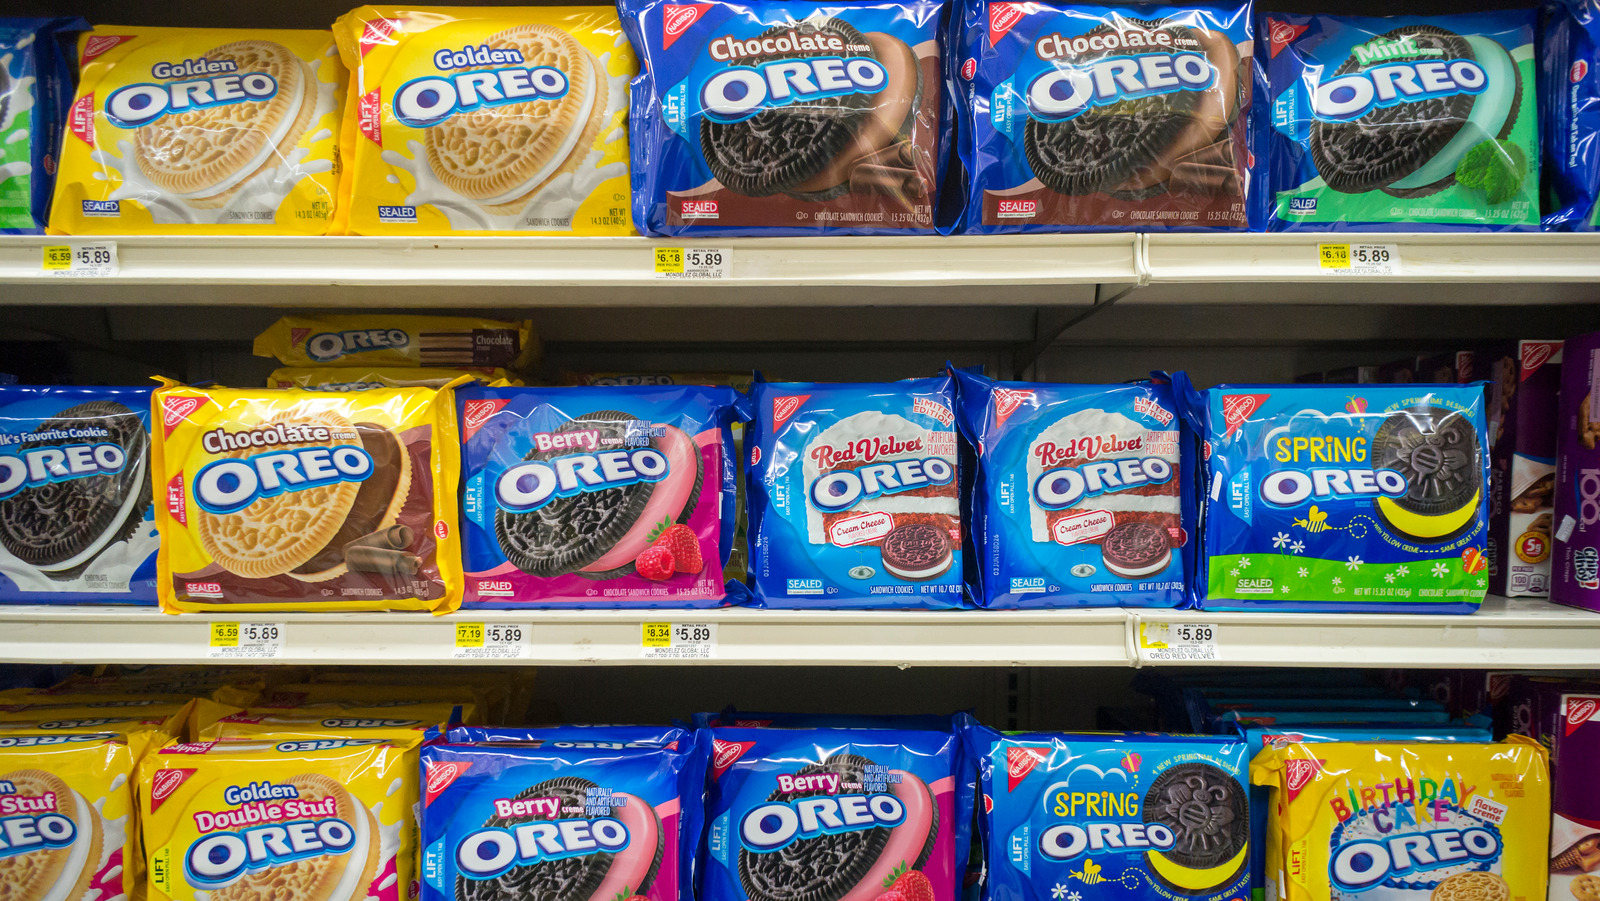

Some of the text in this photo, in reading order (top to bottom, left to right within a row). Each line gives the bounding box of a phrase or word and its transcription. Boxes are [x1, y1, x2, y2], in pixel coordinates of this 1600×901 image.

[668, 9, 695, 33] NABISCO
[711, 32, 870, 60] Chocolate creme
[1038, 31, 1198, 59] Chocolate creme
[1355, 37, 1418, 64] Mint
[153, 59, 236, 79] Golden
[435, 46, 522, 69] Golden
[400, 69, 565, 120] OREO
[704, 60, 884, 115] OREO
[1031, 55, 1210, 113] OREO
[1317, 62, 1485, 116] OREO
[110, 74, 275, 123] OREO
[668, 94, 679, 123] LIFT
[995, 93, 1005, 123] LIFT
[74, 104, 86, 133] LIFT
[362, 102, 373, 132] LIFT
[1276, 100, 1287, 127] LIFT
[83, 201, 119, 212] SEALED
[379, 207, 415, 217] SEALED
[683, 202, 718, 212] SEALED
[814, 212, 883, 221] CHOCOLATE SANDWICH COOKIES
[1000, 202, 1035, 212] SEALED
[551, 218, 570, 226] COOKIES
[49, 251, 110, 264] $6.59 $5.89
[687, 253, 722, 265] $5.89
[1322, 250, 1389, 262] $6.18 $5.89
[310, 328, 513, 361] OREO Chocolate
[167, 401, 195, 425] NABISCO
[466, 403, 494, 428] NABISCO
[776, 398, 797, 420] NABISCO
[913, 405, 951, 427] EDITION
[914, 397, 955, 421] LIMITED
[1135, 397, 1173, 420] LIMITED
[1228, 398, 1253, 422] NABISCO
[22, 427, 108, 442] Favorite Cookie
[203, 425, 356, 452] Chocolate creme
[536, 431, 624, 452] Berry creme
[625, 437, 650, 446] FLAVORED
[1146, 431, 1180, 443] ARTIFICIALLY
[811, 435, 924, 468] Red Velvet
[927, 444, 955, 455] FLAVORED
[1035, 434, 1143, 466] Red Velvet
[1146, 444, 1175, 455] FLAVORED
[1275, 436, 1367, 463] SPRING
[200, 448, 370, 506] OREO
[499, 451, 666, 506] OREO
[814, 459, 952, 507] OREO
[1037, 459, 1171, 505] OREO
[1263, 469, 1405, 504] OREO
[170, 486, 180, 514] LIFT
[467, 486, 476, 514] LIFT
[777, 484, 785, 508] LIFT
[1001, 482, 1010, 506] LIFT
[1232, 481, 1243, 509] LIFT
[836, 517, 886, 536] Cream Cheese
[1060, 516, 1107, 534] Cream Cheese
[1381, 530, 1401, 548] YELLOW
[1440, 543, 1456, 553] SAME
[1456, 534, 1472, 547] GREAT
[1526, 539, 1542, 553] 5g
[1582, 547, 1599, 581] Chips
[187, 583, 221, 593] SEALED
[479, 581, 512, 591] SEALED
[603, 589, 627, 597] CHOCOLATE
[628, 589, 650, 597] SANDWICH
[788, 580, 822, 588] SEALED
[870, 586, 894, 594] SANDWICH
[939, 585, 948, 593] 10.7
[1012, 578, 1045, 587] SEALED
[1090, 583, 1133, 592] SANDWICH COOKIES
[1237, 578, 1273, 588] SEALED
[216, 627, 278, 639] $6.59 $5.89
[458, 629, 521, 641] $7.19 $5.89
[648, 628, 710, 640] $8.34 $5.89
[1178, 628, 1212, 640] $5.89
[1569, 702, 1594, 723] NABISCO
[717, 744, 741, 767] NABISCO
[1157, 759, 1171, 771] NEW
[428, 765, 455, 791] NABISCO
[864, 765, 889, 773] NATURALLY
[864, 775, 903, 783] AND ARTIFICIALLY
[1289, 762, 1310, 790] NABISCO
[154, 771, 180, 798] NABISCO
[226, 782, 298, 803] Golden
[587, 788, 612, 796] NATURALLY
[779, 775, 838, 793] Berry
[864, 784, 887, 792] FLAVORED
[1, 794, 55, 812] Stuf
[497, 799, 560, 818] Berry
[586, 798, 627, 807] AND ARTIFICIALLY
[586, 807, 610, 815] FLAVORED
[1054, 791, 1139, 817] SPRING
[1329, 777, 1477, 823] BIRTHDAY
[1474, 798, 1504, 813] flavor
[196, 799, 335, 831] Double Stuf
[743, 795, 903, 846] OREO
[1373, 799, 1449, 834] CAKE
[1472, 807, 1501, 823] creme
[192, 821, 352, 876] OREO
[459, 820, 626, 873] OREO
[712, 825, 721, 851] LIFT
[1012, 835, 1022, 862] LIFT
[1041, 824, 1174, 858] OREO
[427, 851, 436, 878] LIFT
[1292, 849, 1300, 876] LIFT
[1335, 830, 1497, 885] OREO
[155, 857, 164, 884] LIFT
[1152, 883, 1239, 899] YELLOW GREAT
